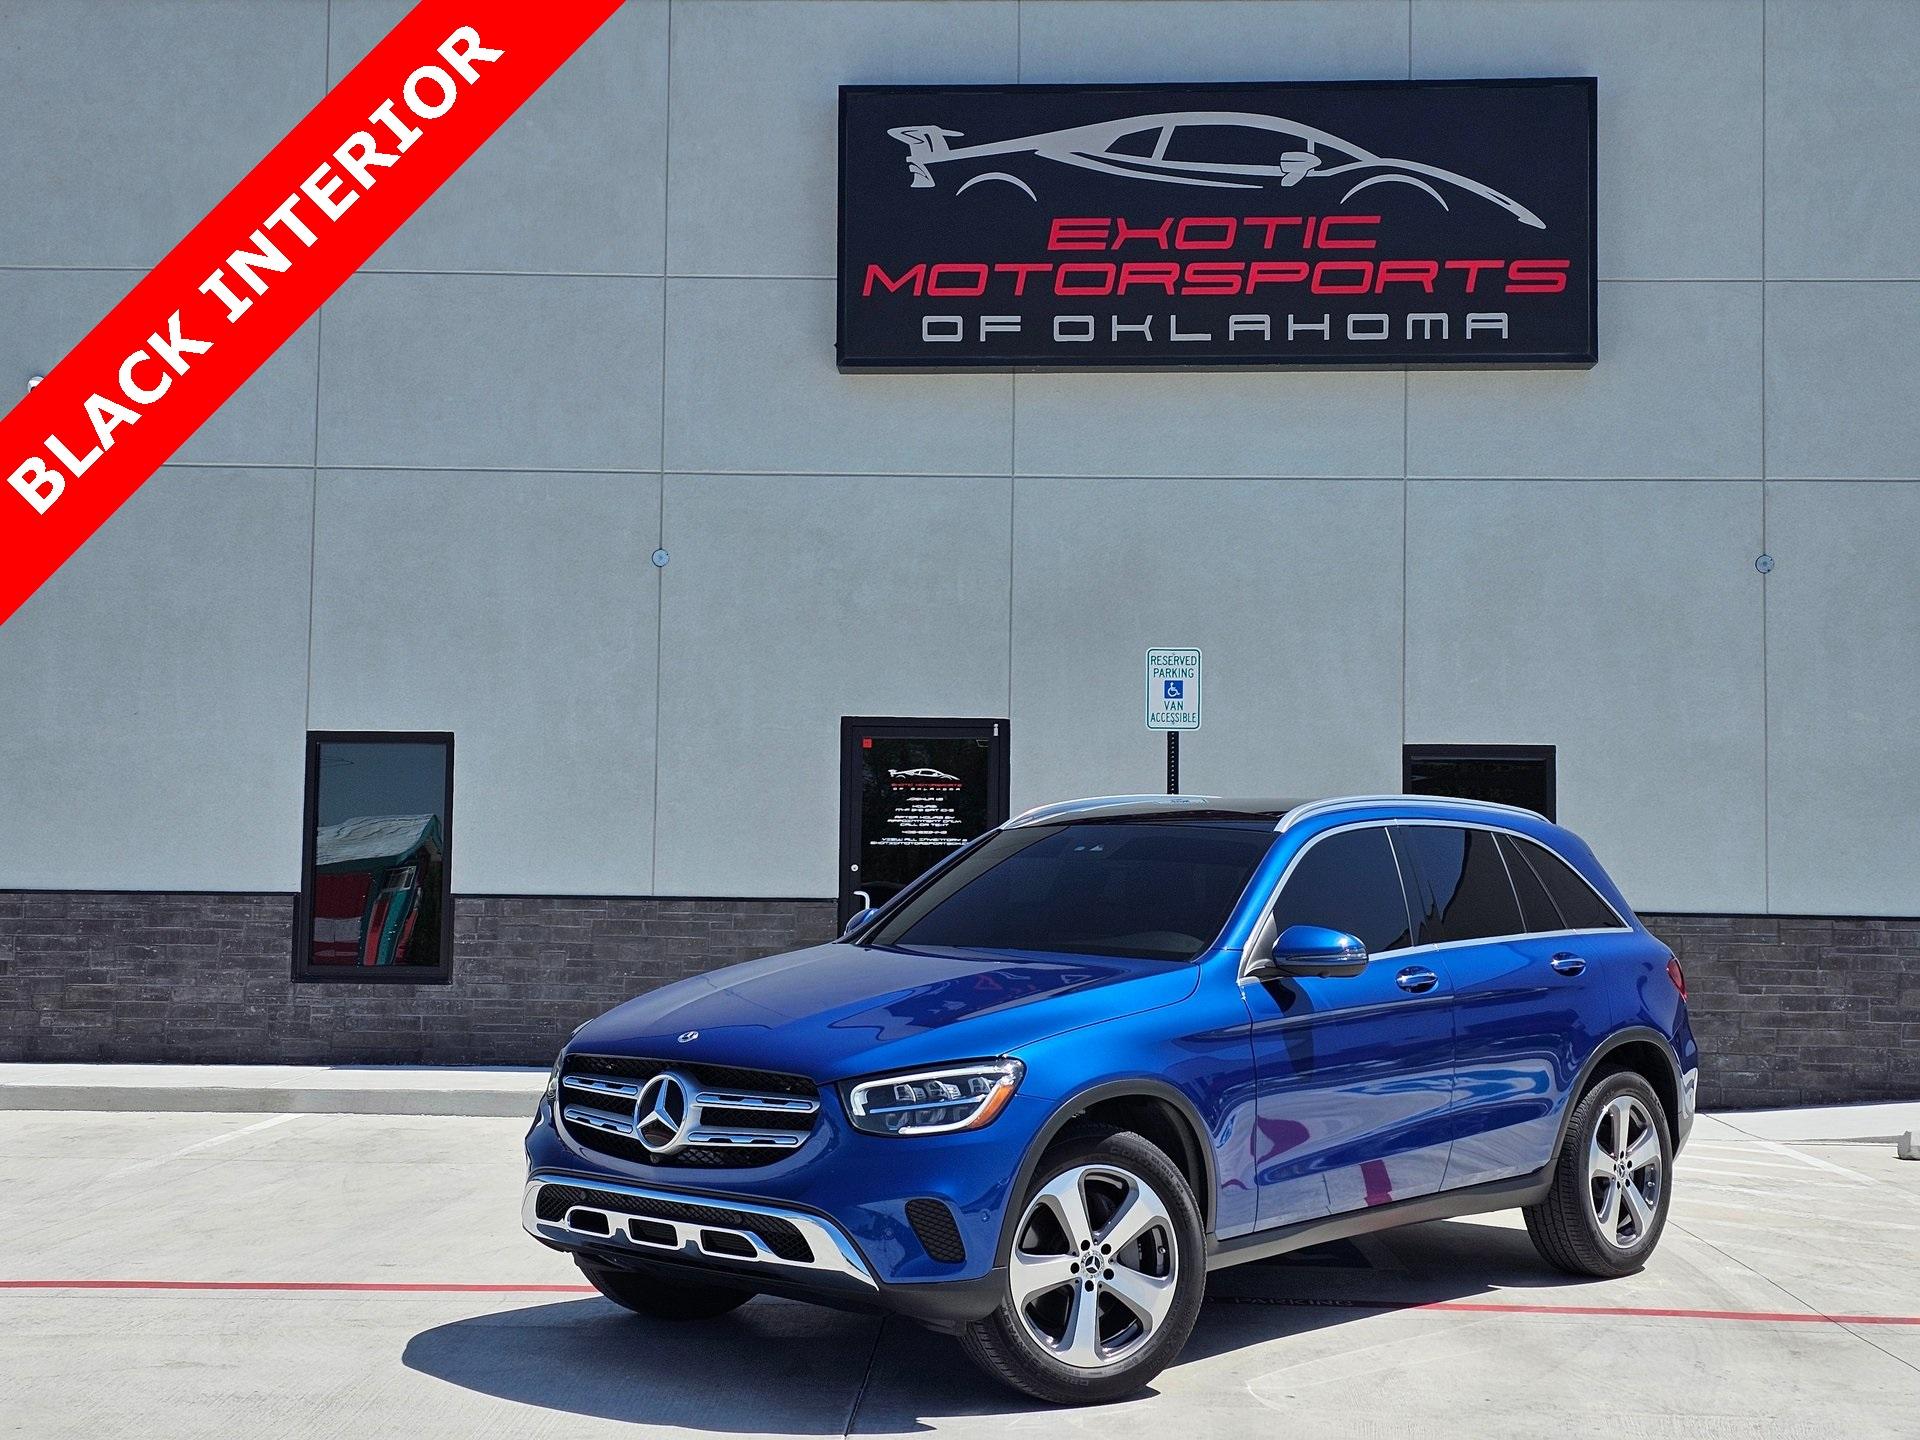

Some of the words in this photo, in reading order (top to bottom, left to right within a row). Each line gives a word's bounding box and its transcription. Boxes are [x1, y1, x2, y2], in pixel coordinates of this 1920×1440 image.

[1048, 216, 1381, 250] EXOTIC
[862, 259, 1570, 297] MOTORSPORTS
[922, 315, 1021, 342] OF
[1053, 313, 1509, 342] OKLAHOMA
[1150, 655, 1197, 666] RESERVED
[1153, 667, 1194, 678] PARKING
[1164, 700, 1184, 711] VAN
[1150, 712, 1197, 723] ACCESSIBLE
